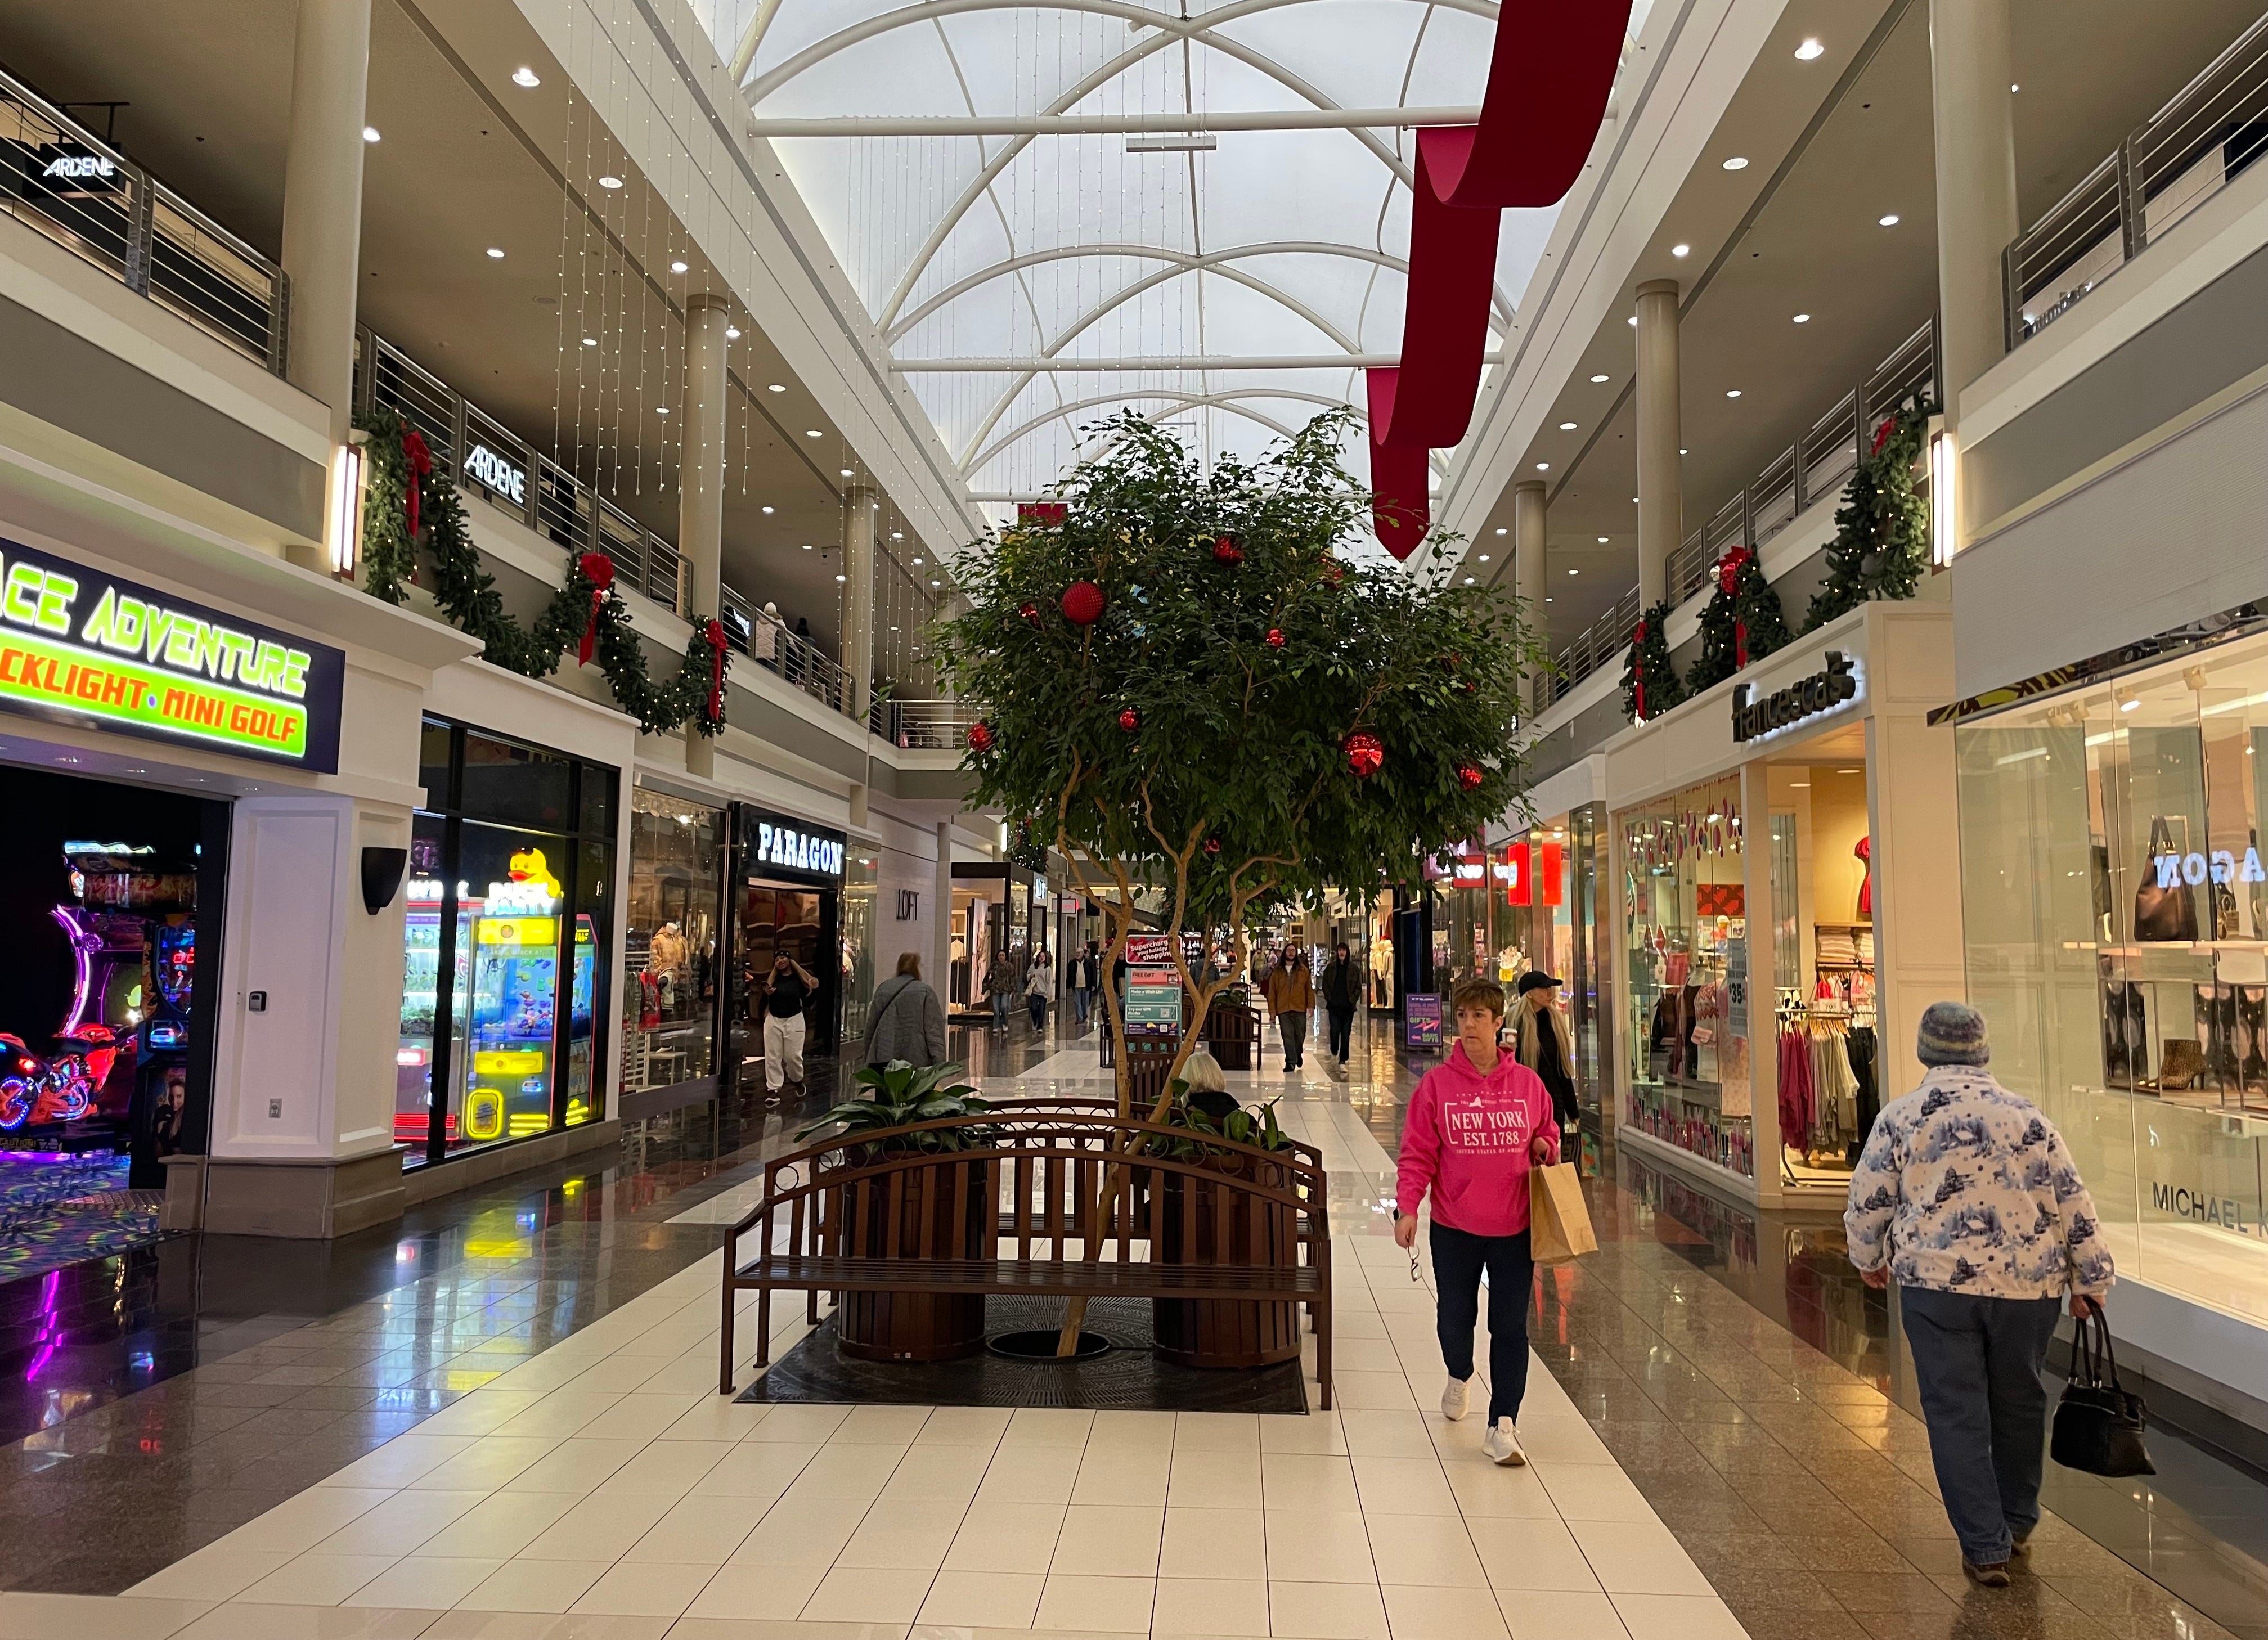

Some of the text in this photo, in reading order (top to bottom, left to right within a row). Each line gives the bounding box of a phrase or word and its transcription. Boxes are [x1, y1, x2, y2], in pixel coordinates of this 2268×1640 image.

[43, 157, 114, 176] ARDENE
[464, 445, 524, 504] ARDENE
[0, 550, 311, 698] CE ADVENTURE
[162, 688, 226, 728] MINI
[230, 704, 298, 743] GOLF
[758, 823, 842, 875] PARAGON
[896, 889, 919, 920] LOFT
[1130, 940, 1169, 952] Supercharg
[1452, 1111, 1526, 1130] NEW YORK
[1463, 1131, 1519, 1146] EST. 1788
[2153, 1181, 2248, 1233] MICHAEL
